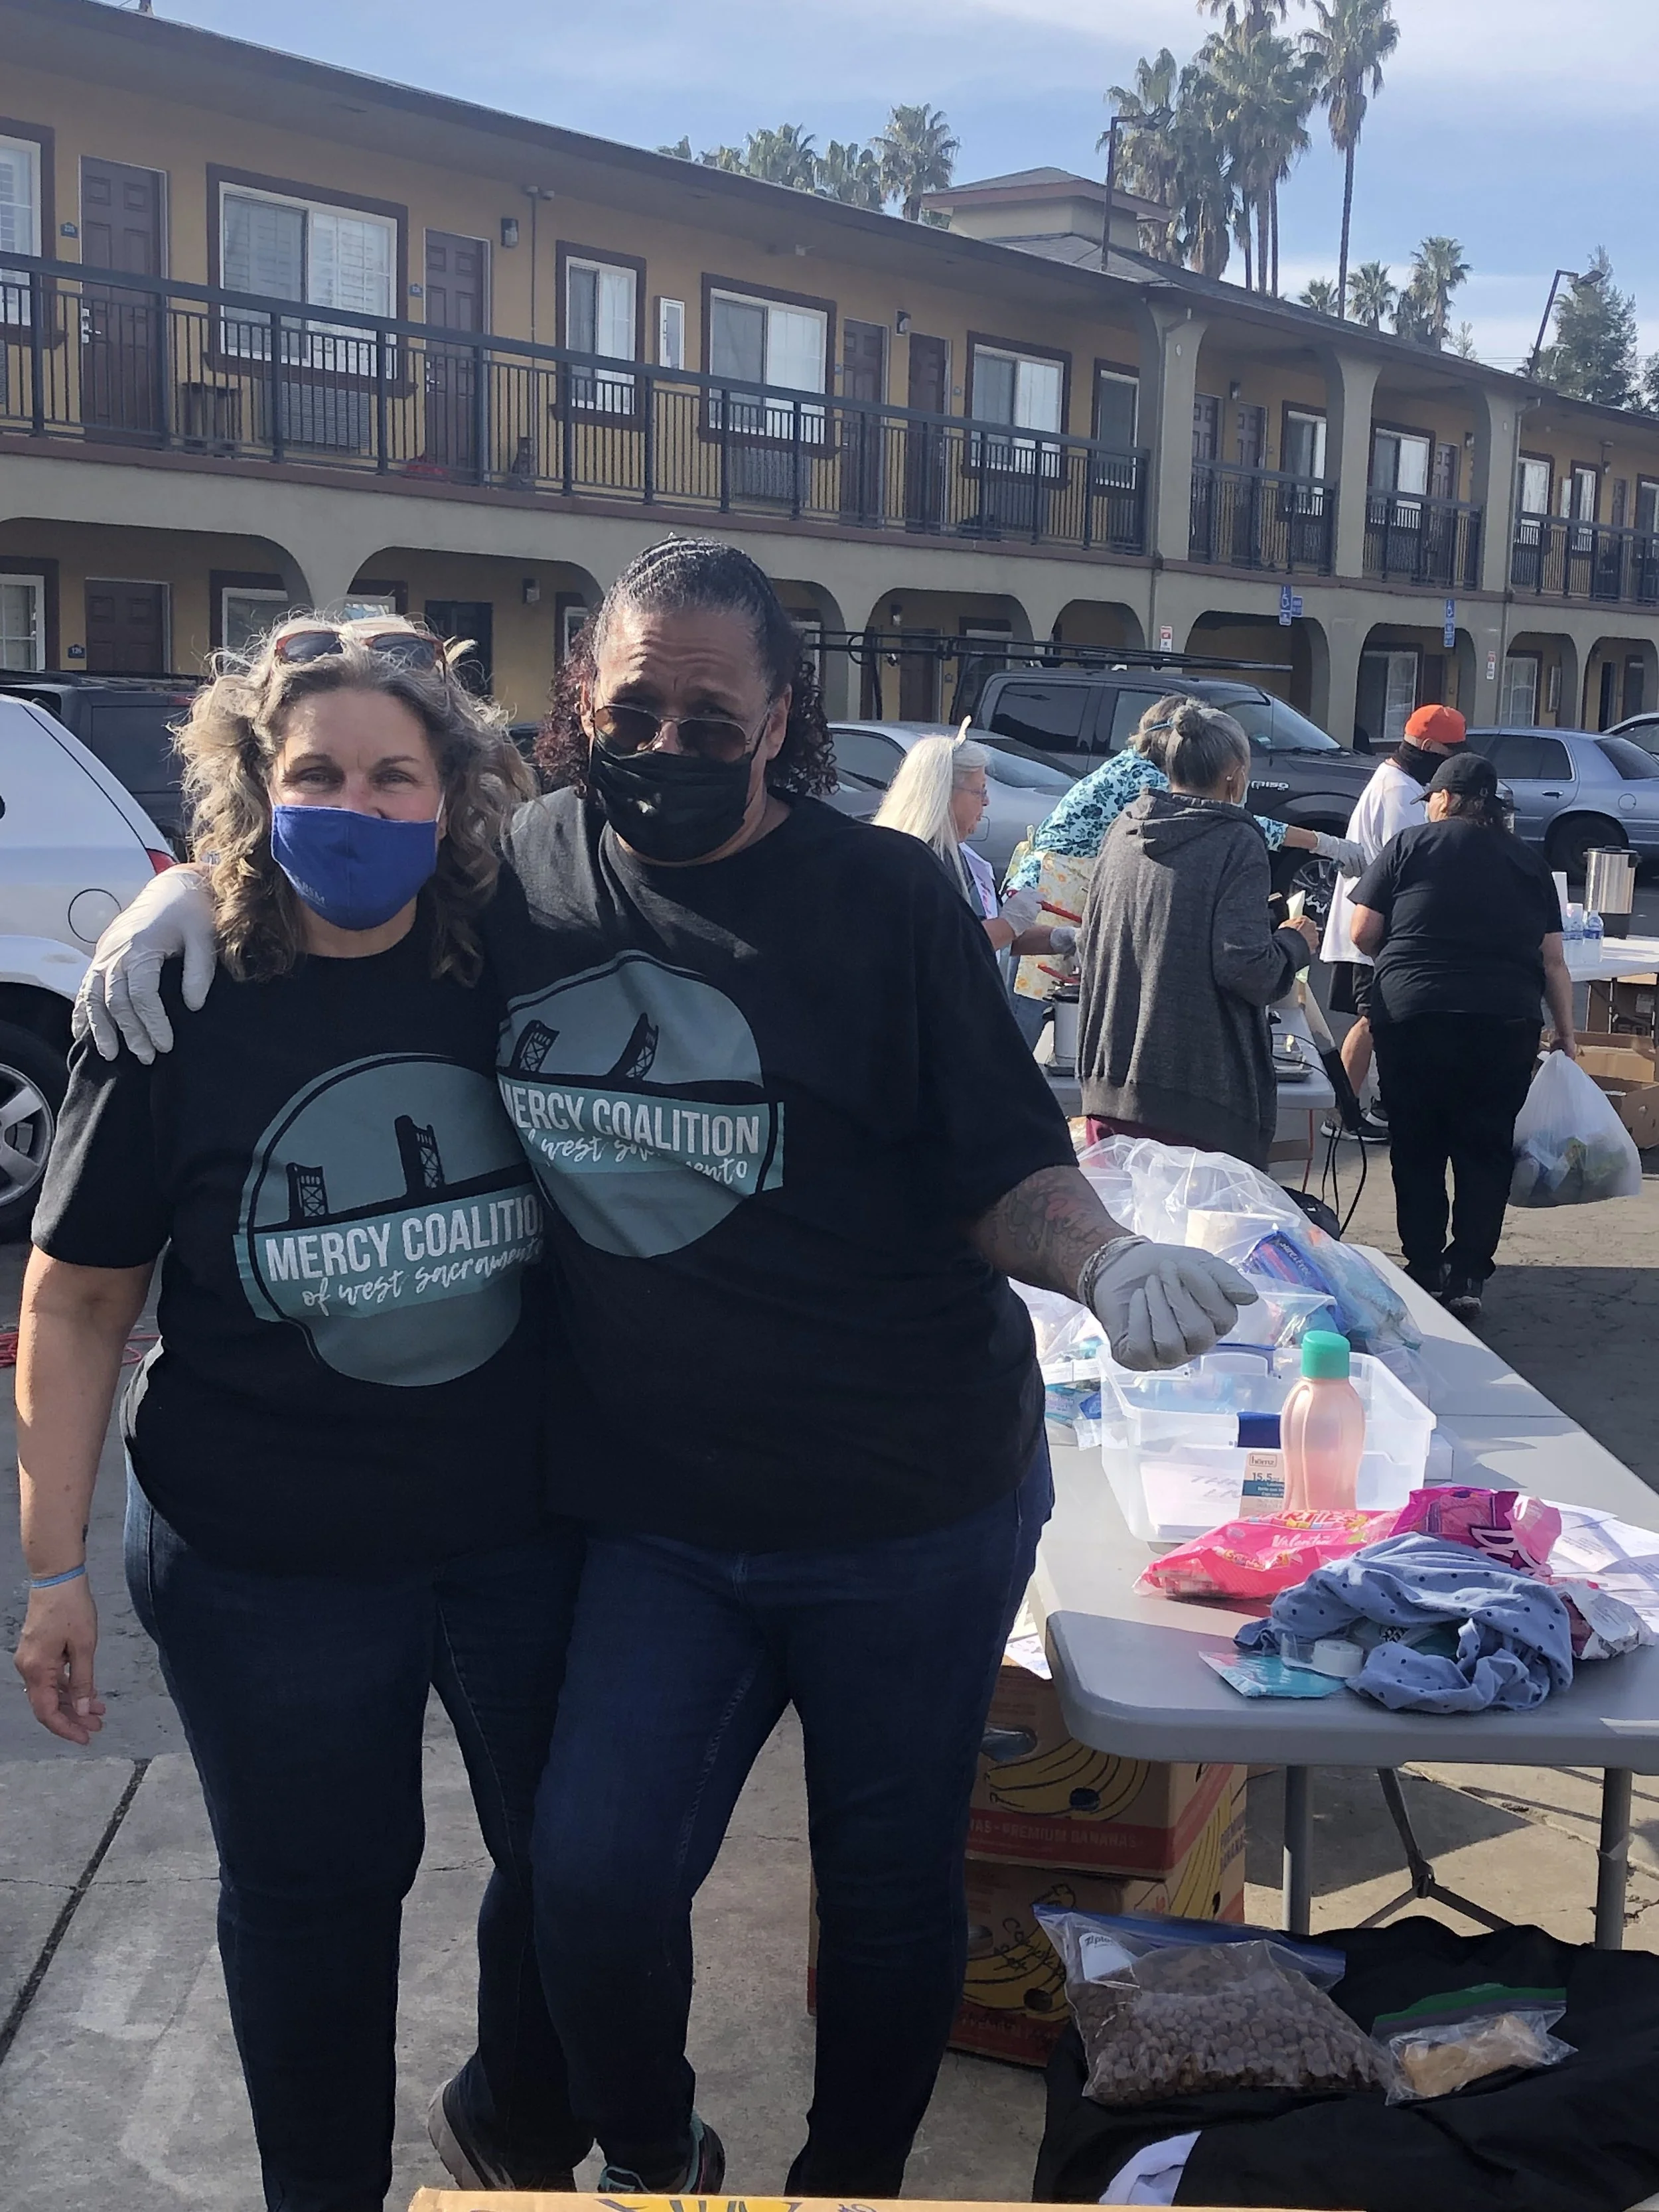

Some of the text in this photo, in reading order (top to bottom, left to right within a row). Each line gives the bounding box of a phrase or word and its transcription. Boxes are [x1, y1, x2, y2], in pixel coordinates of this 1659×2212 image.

[541, 1135, 608, 1162] west
[593, 1098, 760, 1157] COALITION
[265, 1222, 391, 1282] MERCY
[303, 1277, 330, 1317] of
[338, 1270, 406, 1305] west
